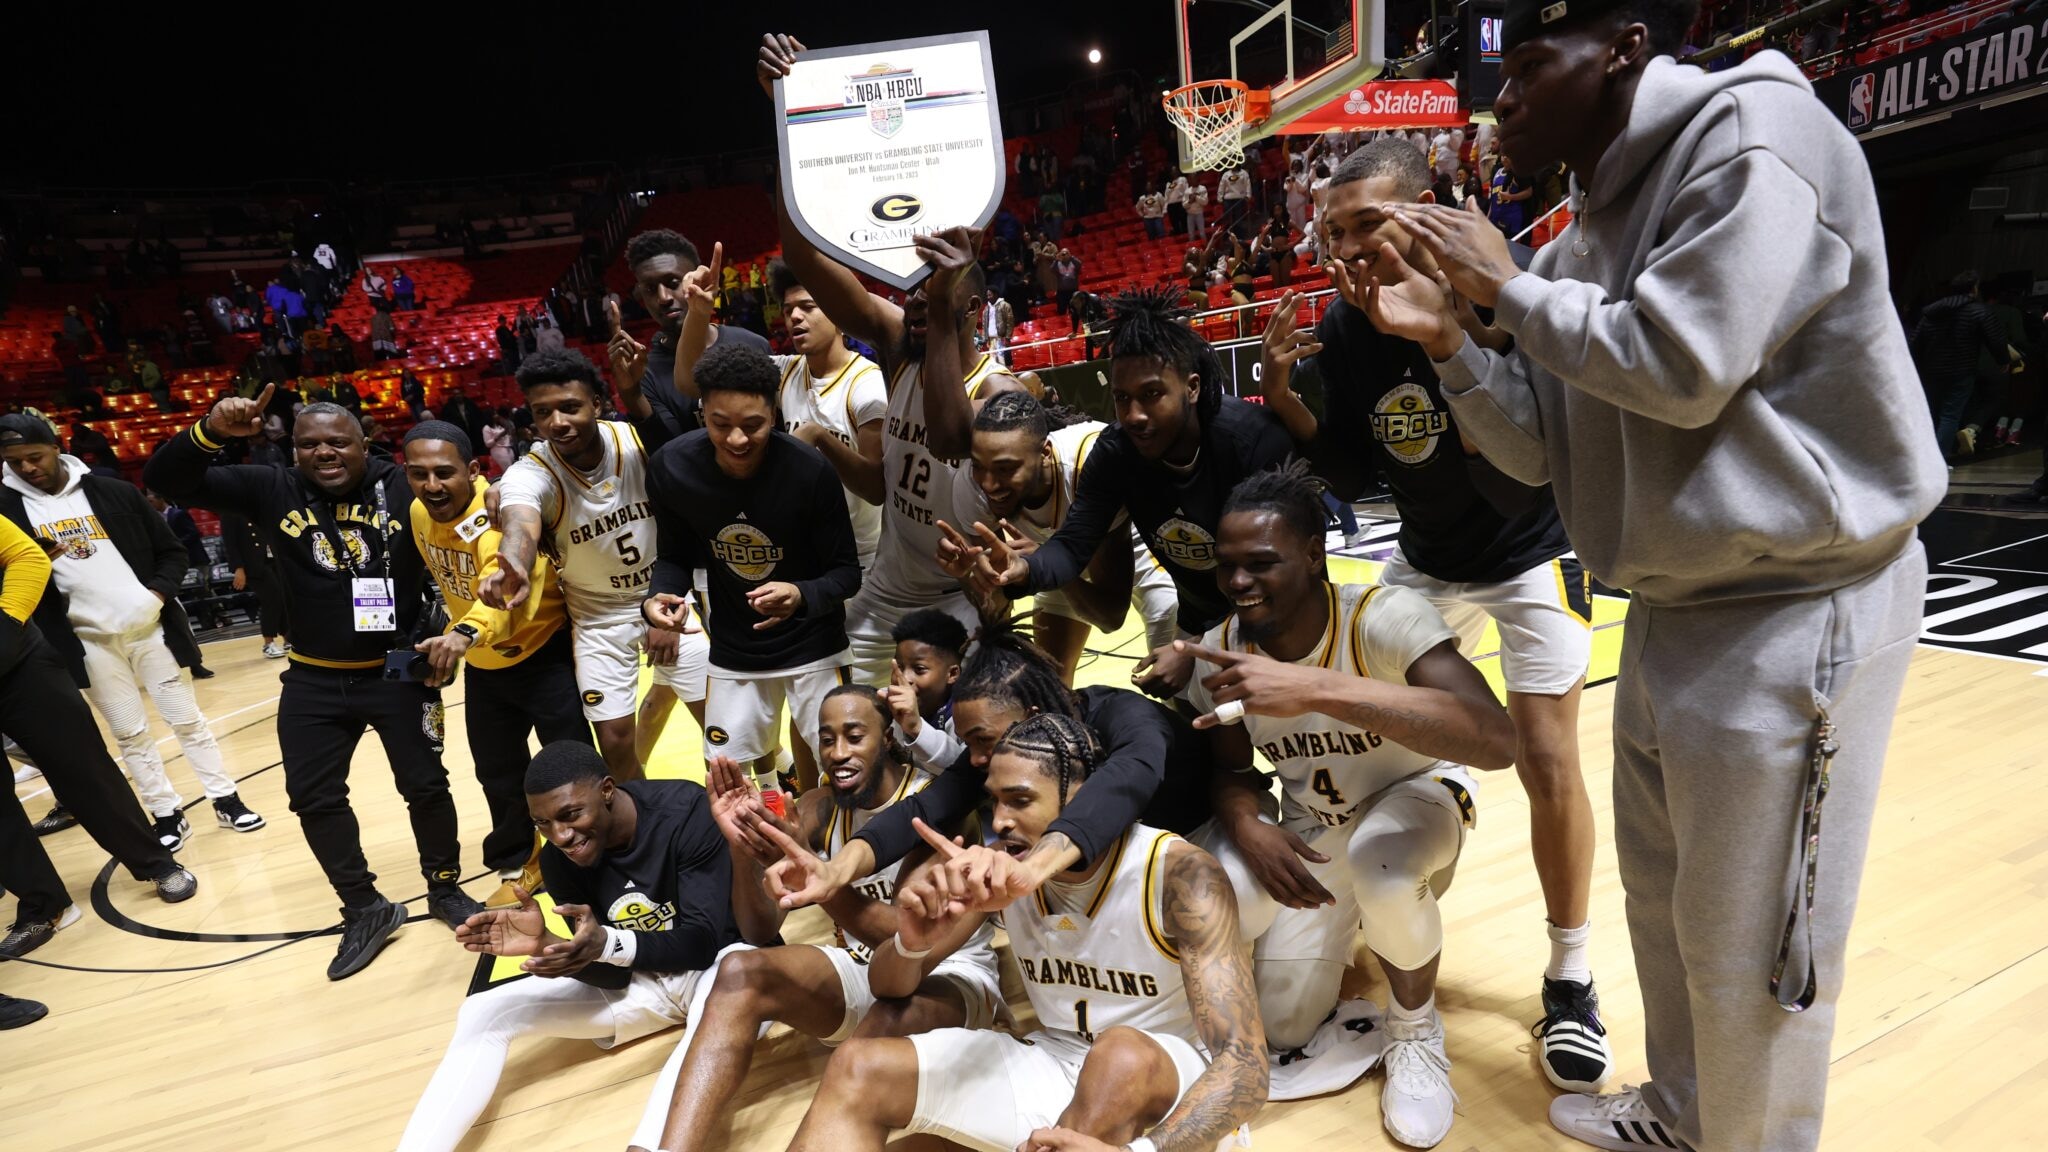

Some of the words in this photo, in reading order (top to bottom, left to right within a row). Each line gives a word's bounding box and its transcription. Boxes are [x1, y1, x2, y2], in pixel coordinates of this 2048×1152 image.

[855, 82, 882, 102] NBA
[886, 77, 923, 99] HBCU
[1877, 57, 1929, 120] ALL
[1938, 25, 2035, 101] STAR
[798, 156, 834, 169] SOUTHERN
[835, 152, 872, 165] UNIVERSITY
[884, 146, 922, 159] GRAMBLING
[923, 142, 943, 154] STATE
[945, 138, 984, 151] UNIVERSITY
[1367, 411, 1449, 442] HBCU
[898, 453, 931, 500] 12
[570, 500, 656, 545] GRAMBLIN
[893, 490, 933, 526] STATE
[615, 531, 642, 567] 5
[709, 539, 784, 564] HBCU
[1312, 768, 1345, 805] 4
[1074, 1000, 1089, 1032] 1
